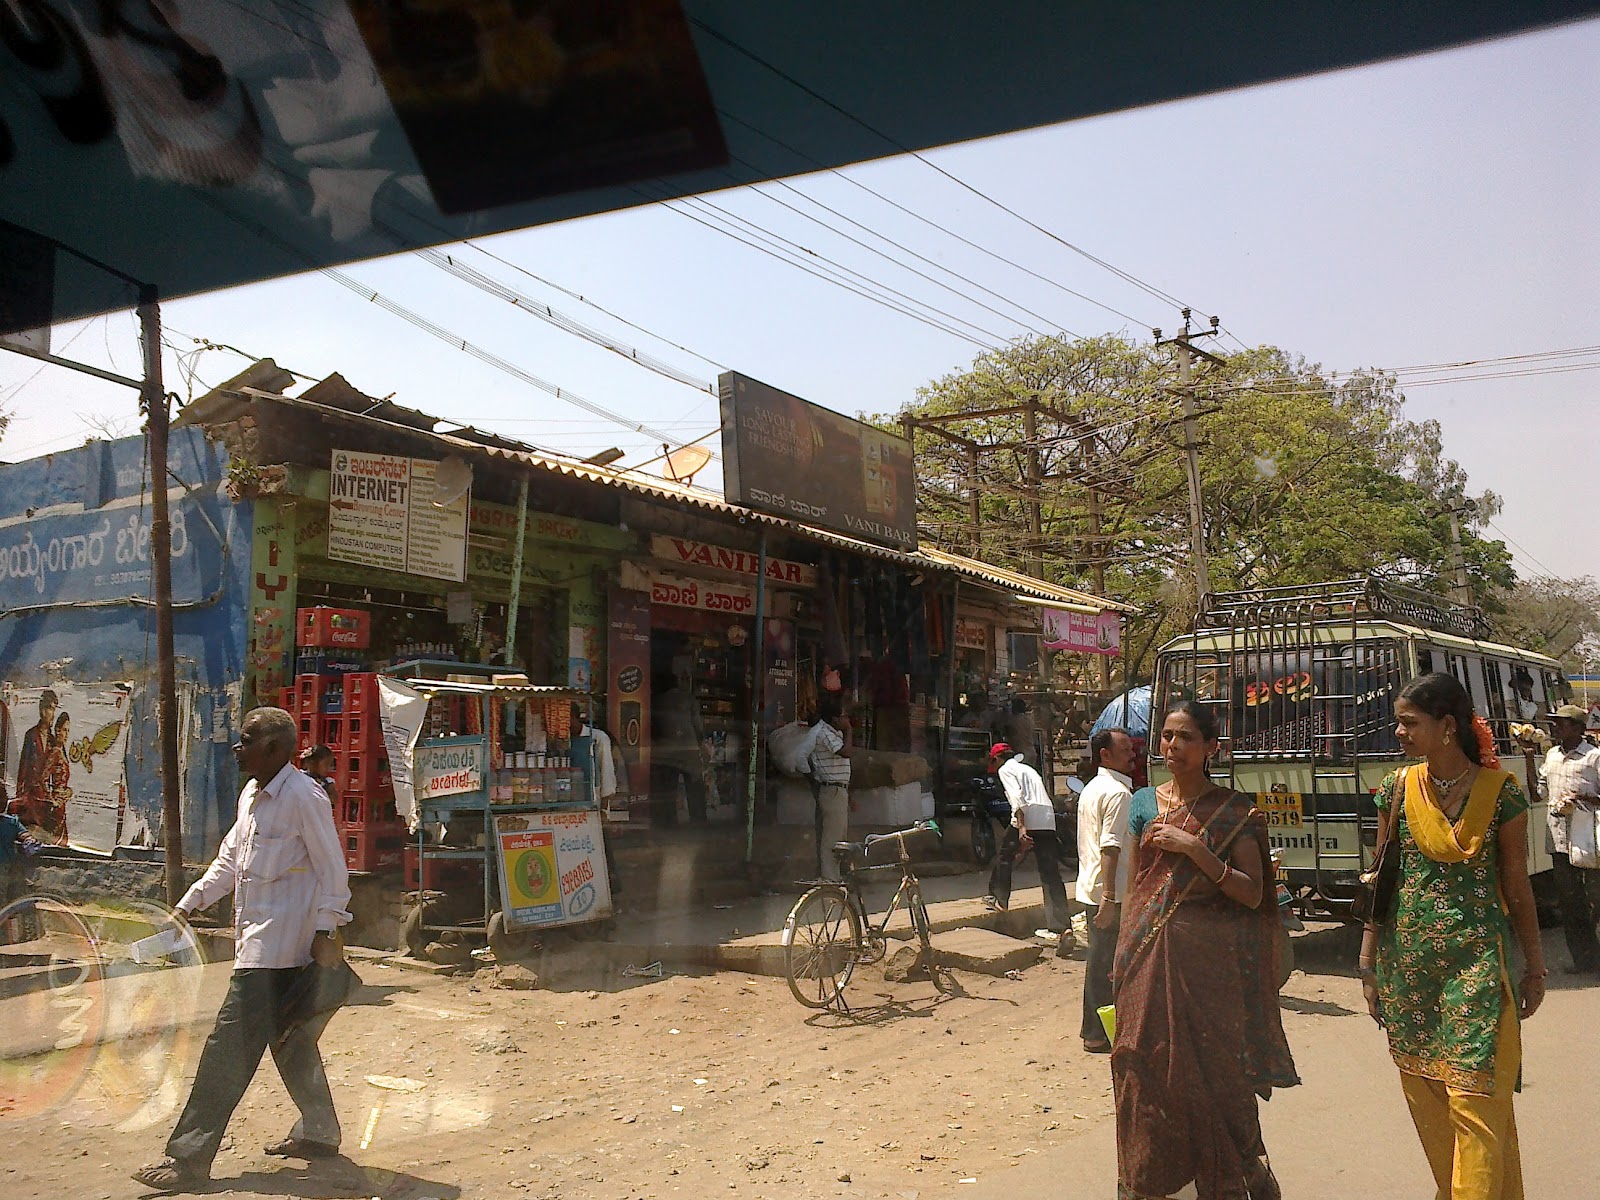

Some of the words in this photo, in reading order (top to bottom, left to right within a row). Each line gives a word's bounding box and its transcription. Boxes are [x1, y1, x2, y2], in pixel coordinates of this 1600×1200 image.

[332, 473, 408, 504] INTERNET
[844, 514, 881, 536] VANI
[883, 526, 912, 544] BAR
[330, 535, 364, 548] HINDUSTAN
[364, 541, 404, 555] COMPUTERS
[671, 538, 746, 572] VANI
[653, 582, 698, 606] ವಾಣಿ
[705, 592, 752, 612] ಬಾರ್
[334, 662, 361, 672] PEPSI
[1265, 795, 1280, 805] KA
[1284, 796, 1296, 805] 16
